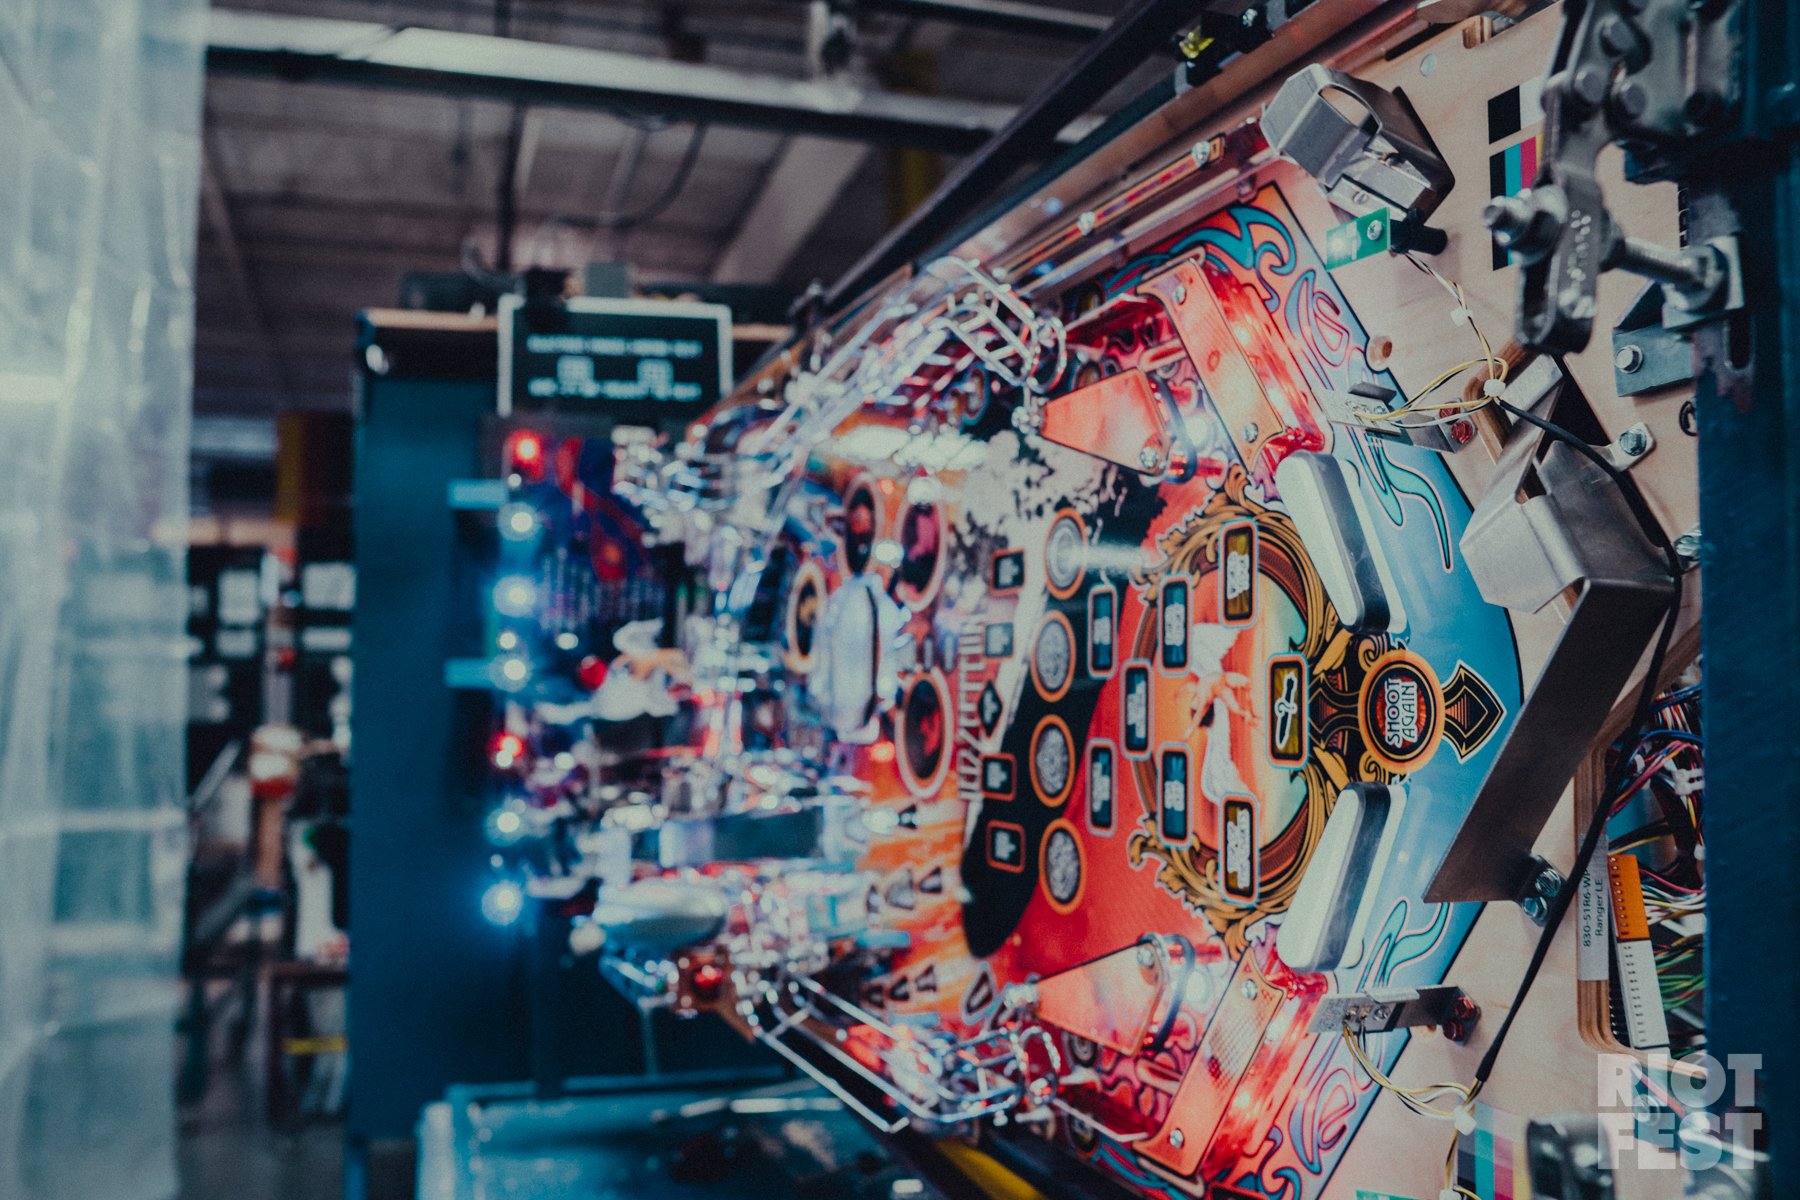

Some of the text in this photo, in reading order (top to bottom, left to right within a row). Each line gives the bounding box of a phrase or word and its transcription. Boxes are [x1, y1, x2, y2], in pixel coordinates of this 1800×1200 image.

[1386, 679, 1401, 745] SHOOT
[1401, 684, 1416, 739] AGAIN
[1594, 879, 1606, 937] Ranger LE
